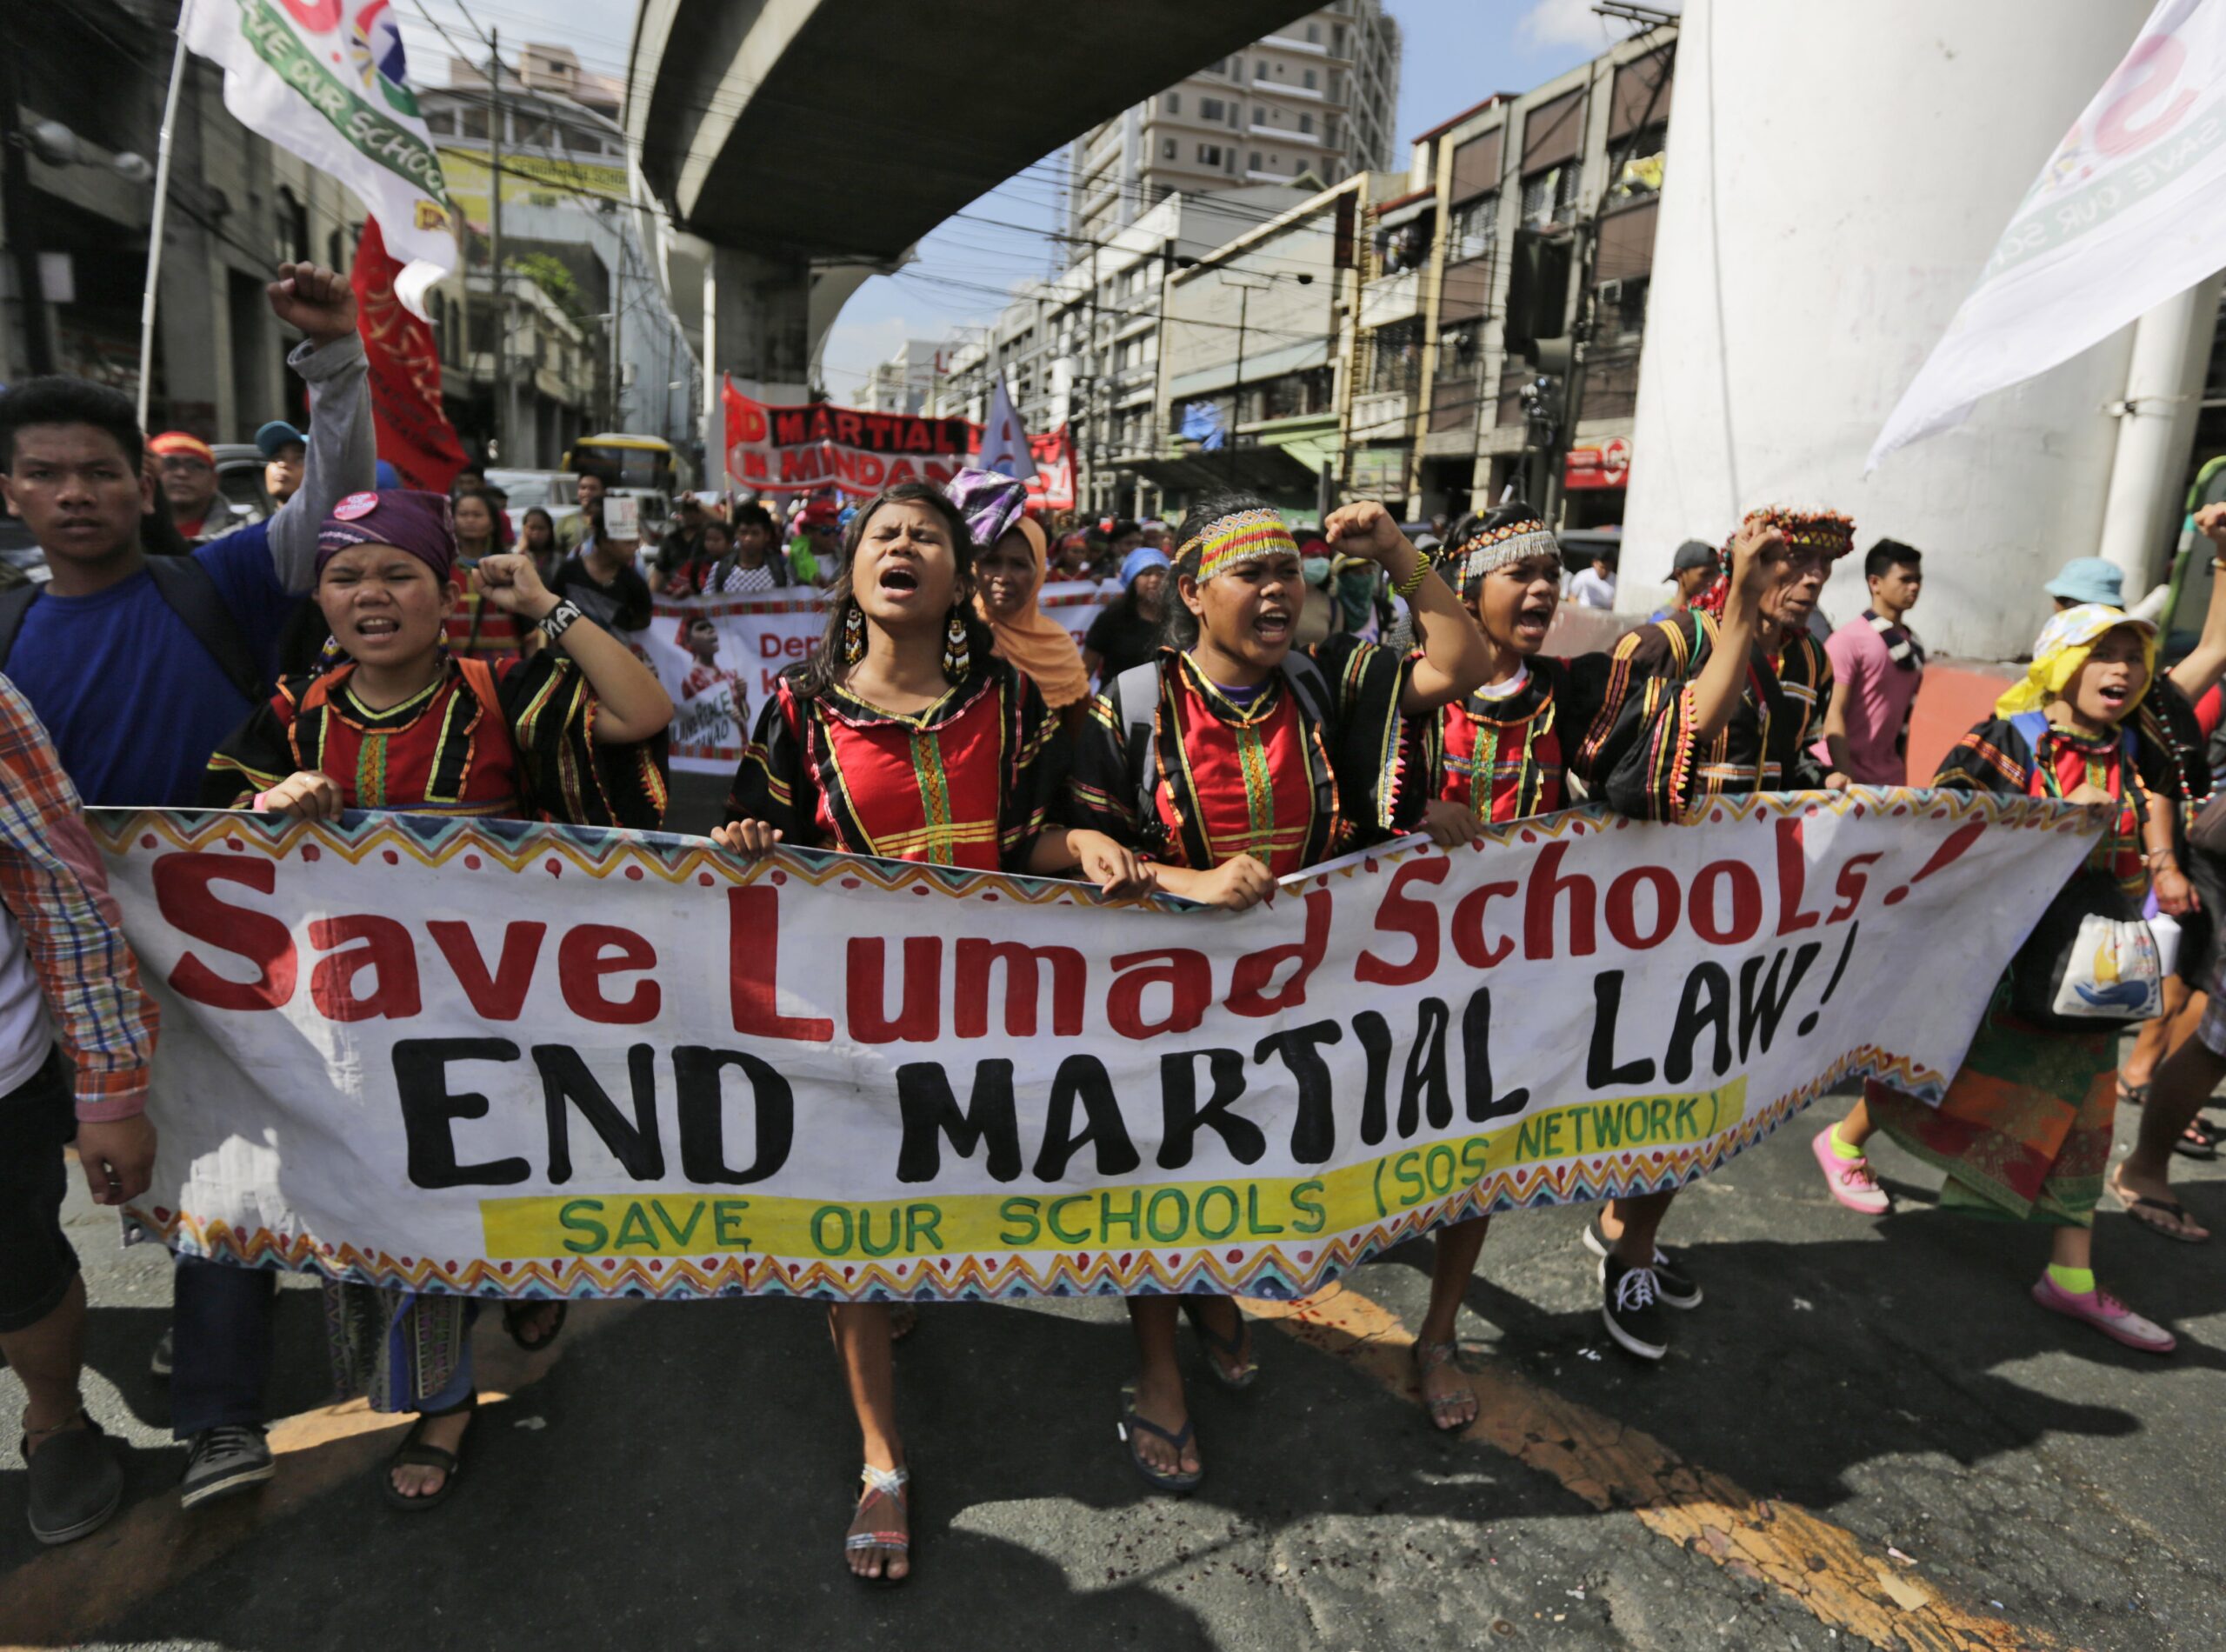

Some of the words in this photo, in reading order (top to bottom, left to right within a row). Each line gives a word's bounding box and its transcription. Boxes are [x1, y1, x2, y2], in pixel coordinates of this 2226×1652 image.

[290, 58, 347, 117] OUR
[347, 110, 446, 203] SCHOO
[776, 408, 956, 453] MARTIAL
[151, 850, 662, 1024] Save
[728, 884, 1332, 1043] Lumad
[391, 1036, 795, 1189] END
[896, 987, 1530, 1183] MARTIAL
[1586, 920, 1859, 1090] LAW!
[559, 1200, 750, 1254] SAVE
[810, 1202, 944, 1256] OUR
[1000, 1179, 1327, 1246] SCHOOLS
[1373, 1137, 1490, 1218] (SOS
[1516, 1091, 1719, 1164] NETWORK)
